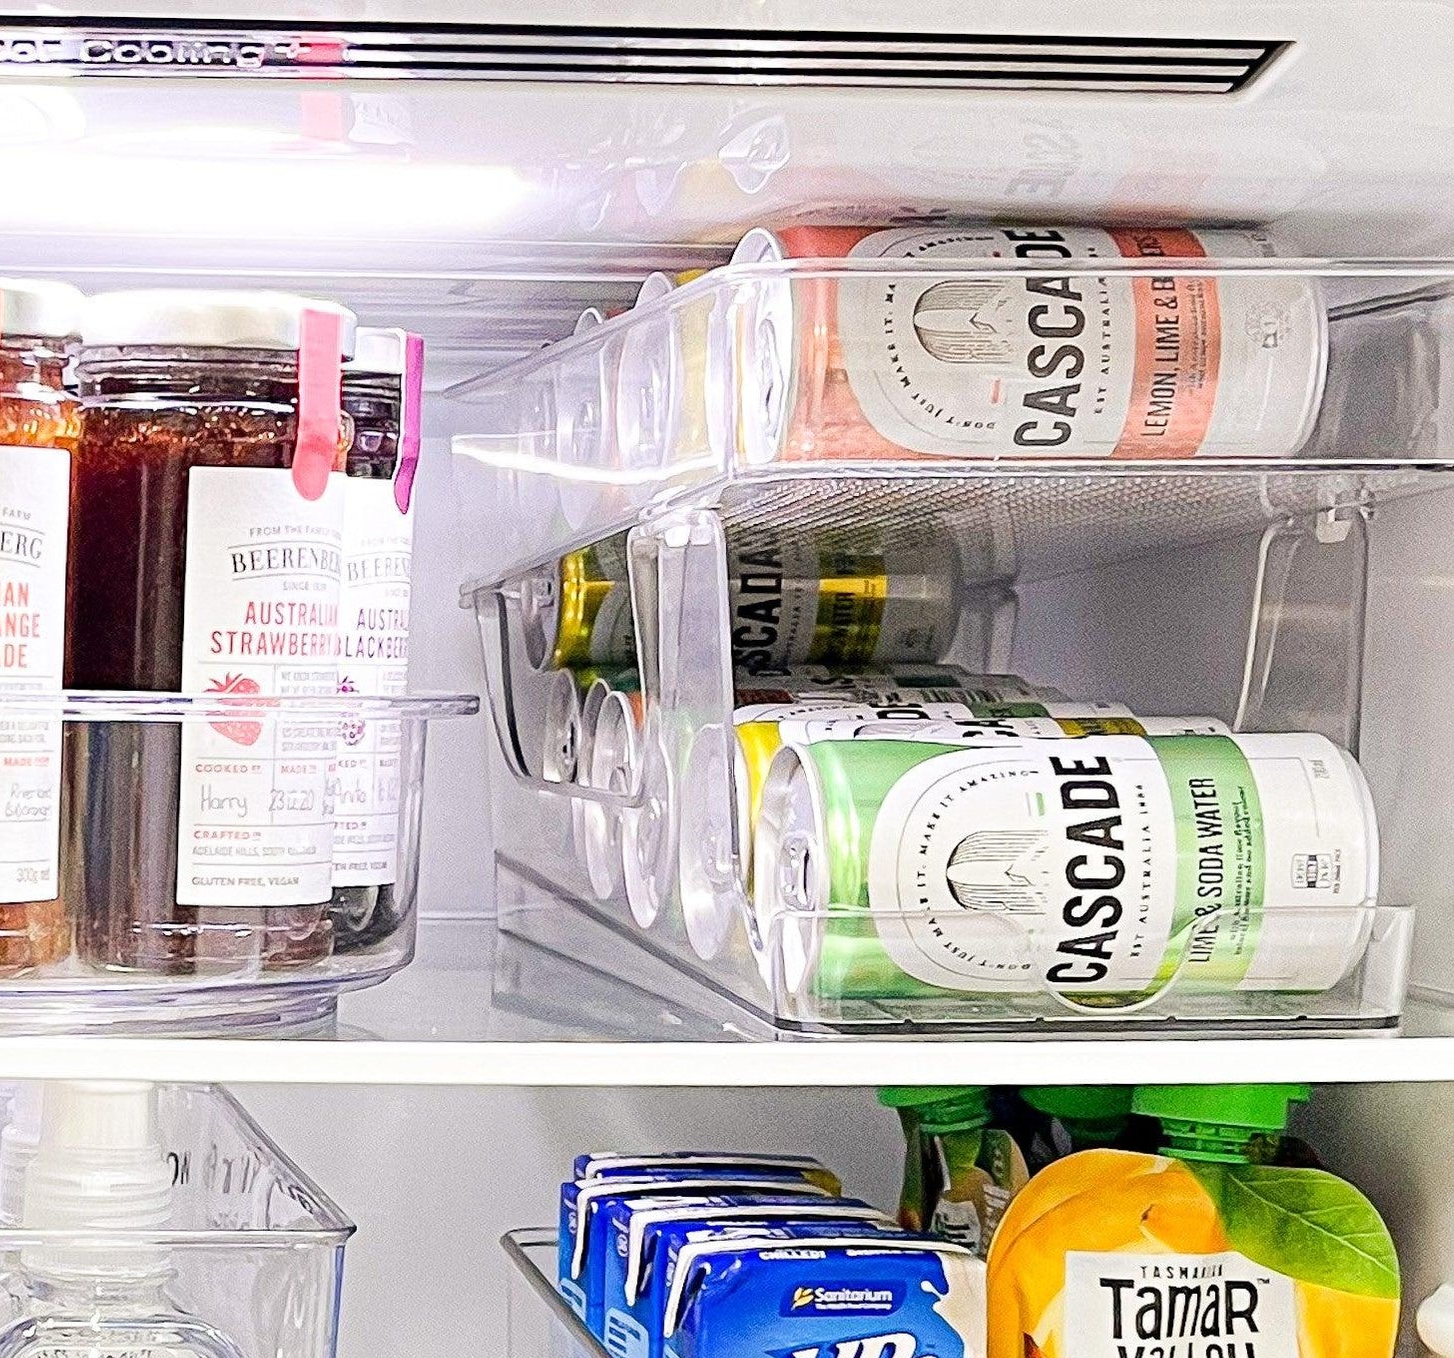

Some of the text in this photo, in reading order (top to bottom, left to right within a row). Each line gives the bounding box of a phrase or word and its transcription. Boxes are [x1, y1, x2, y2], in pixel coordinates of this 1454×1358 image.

[1153, 296, 1179, 310] &
[1002, 227, 1086, 448] CASCADE
[1152, 314, 1182, 362] LIME
[1140, 367, 1182, 437] LEMON,
[3, 757, 32, 767] MADE
[195, 764, 248, 774] COOKED
[194, 830, 249, 840] CRAFTED
[192, 876, 236, 887] GLUTEN
[1046, 754, 1127, 985] CASCADE
[1137, 825, 1152, 924] AUSTRALIA
[1188, 777, 1225, 964] LIME & SODA WATER
[814, 1287, 893, 1303] Sanitarium
